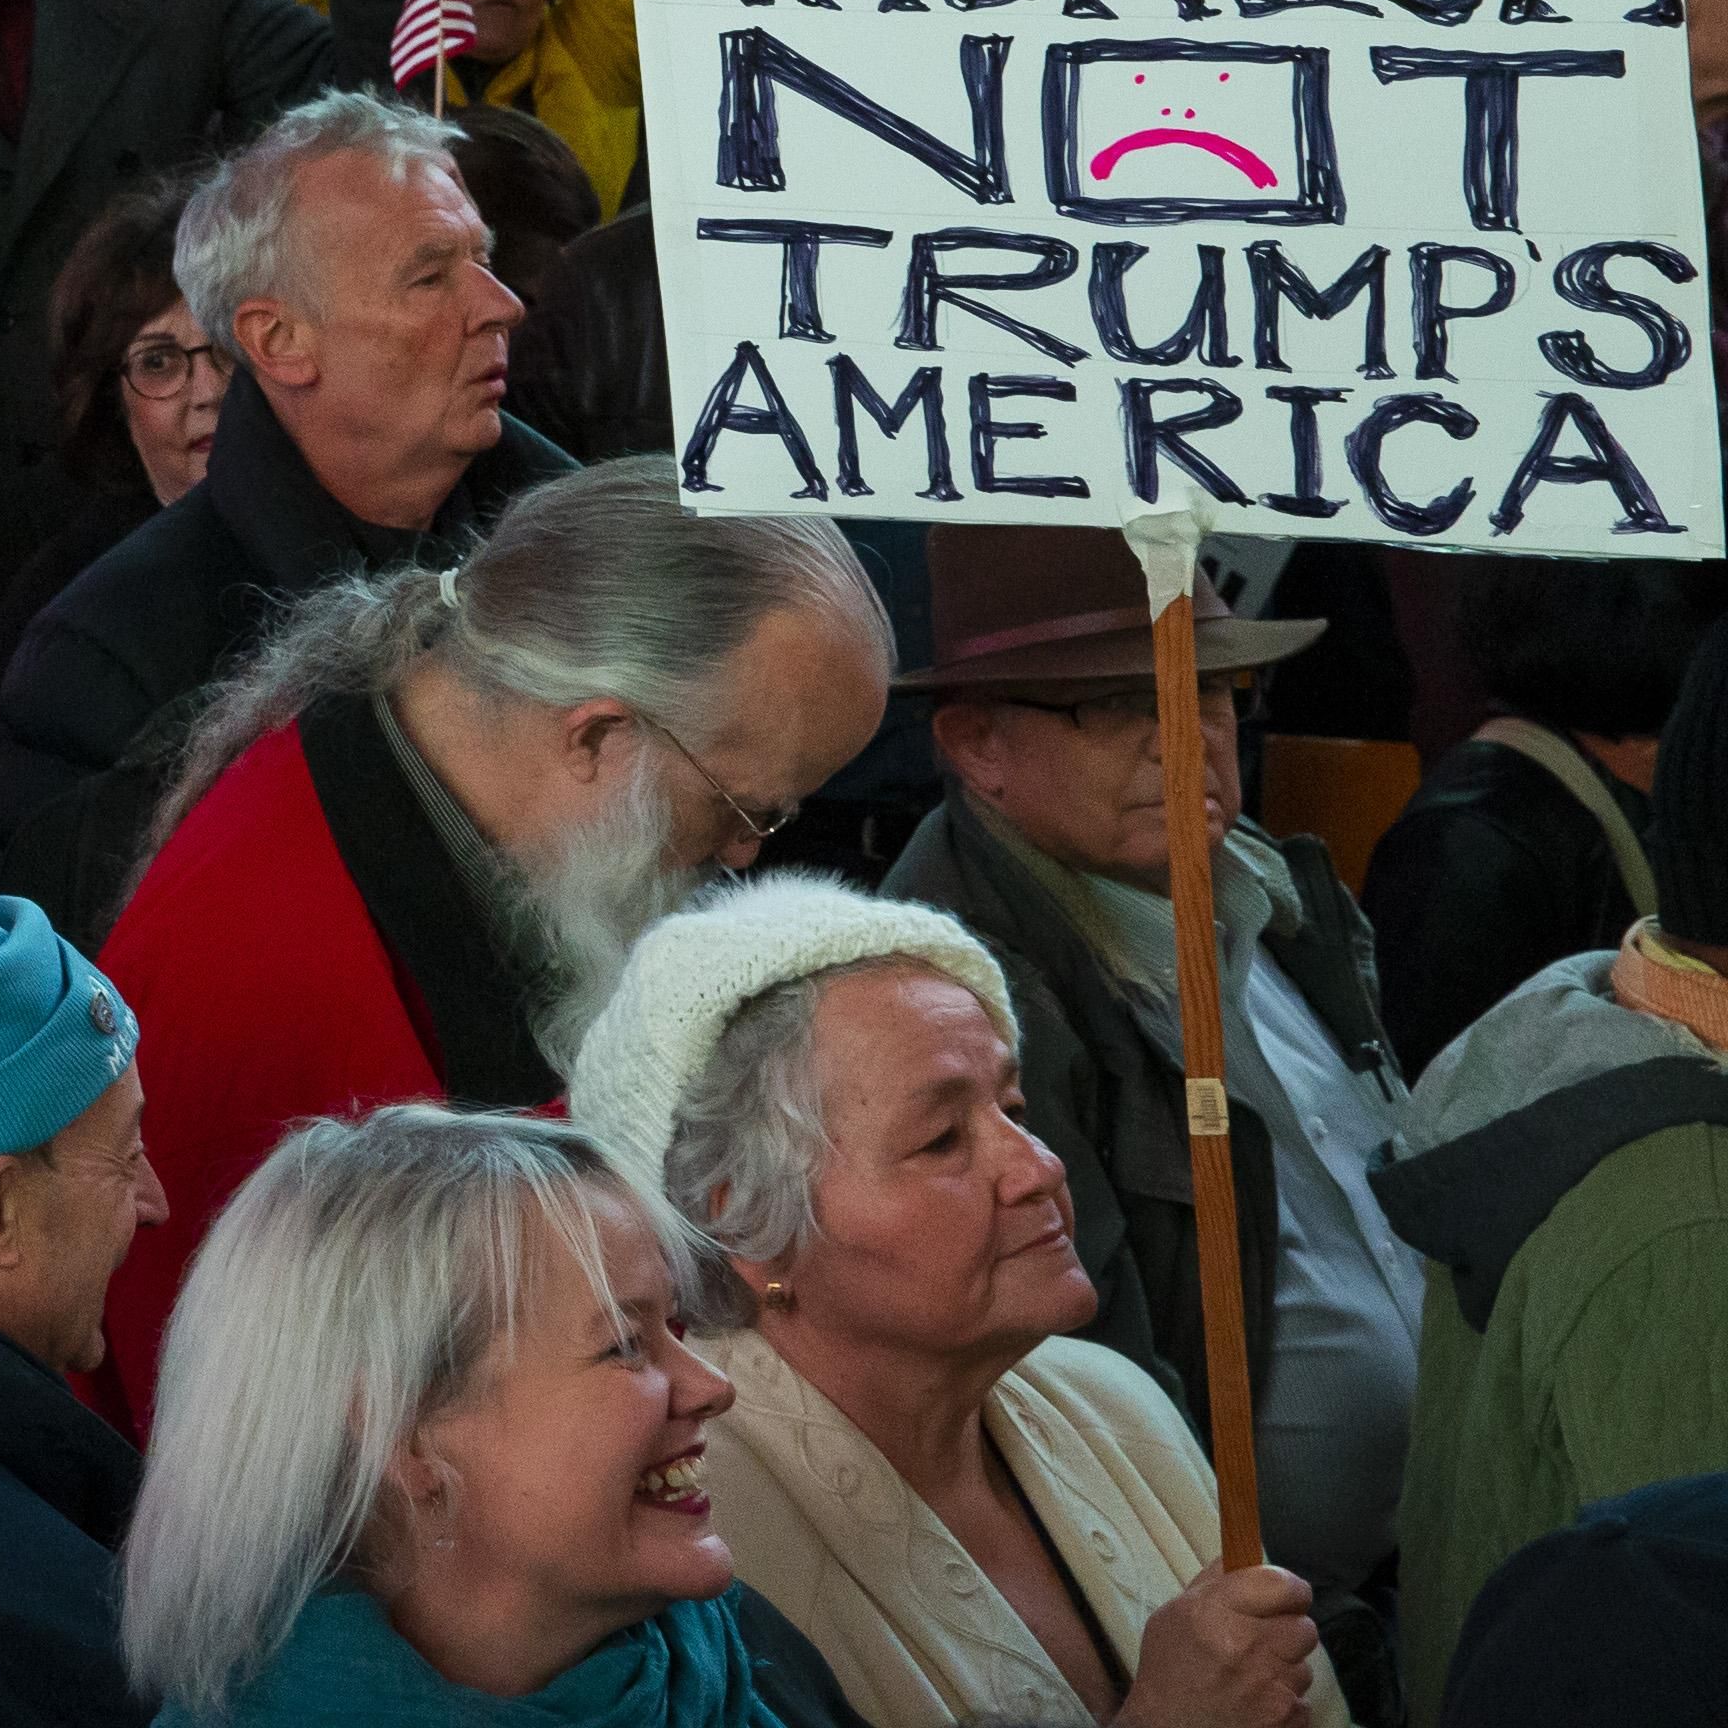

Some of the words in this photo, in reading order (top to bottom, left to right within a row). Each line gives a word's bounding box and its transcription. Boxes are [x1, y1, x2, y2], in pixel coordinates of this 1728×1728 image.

[716, 27, 1626, 234] NOT
[696, 219, 1698, 391] TRUMP'S
[682, 340, 1685, 537] AMERICA
